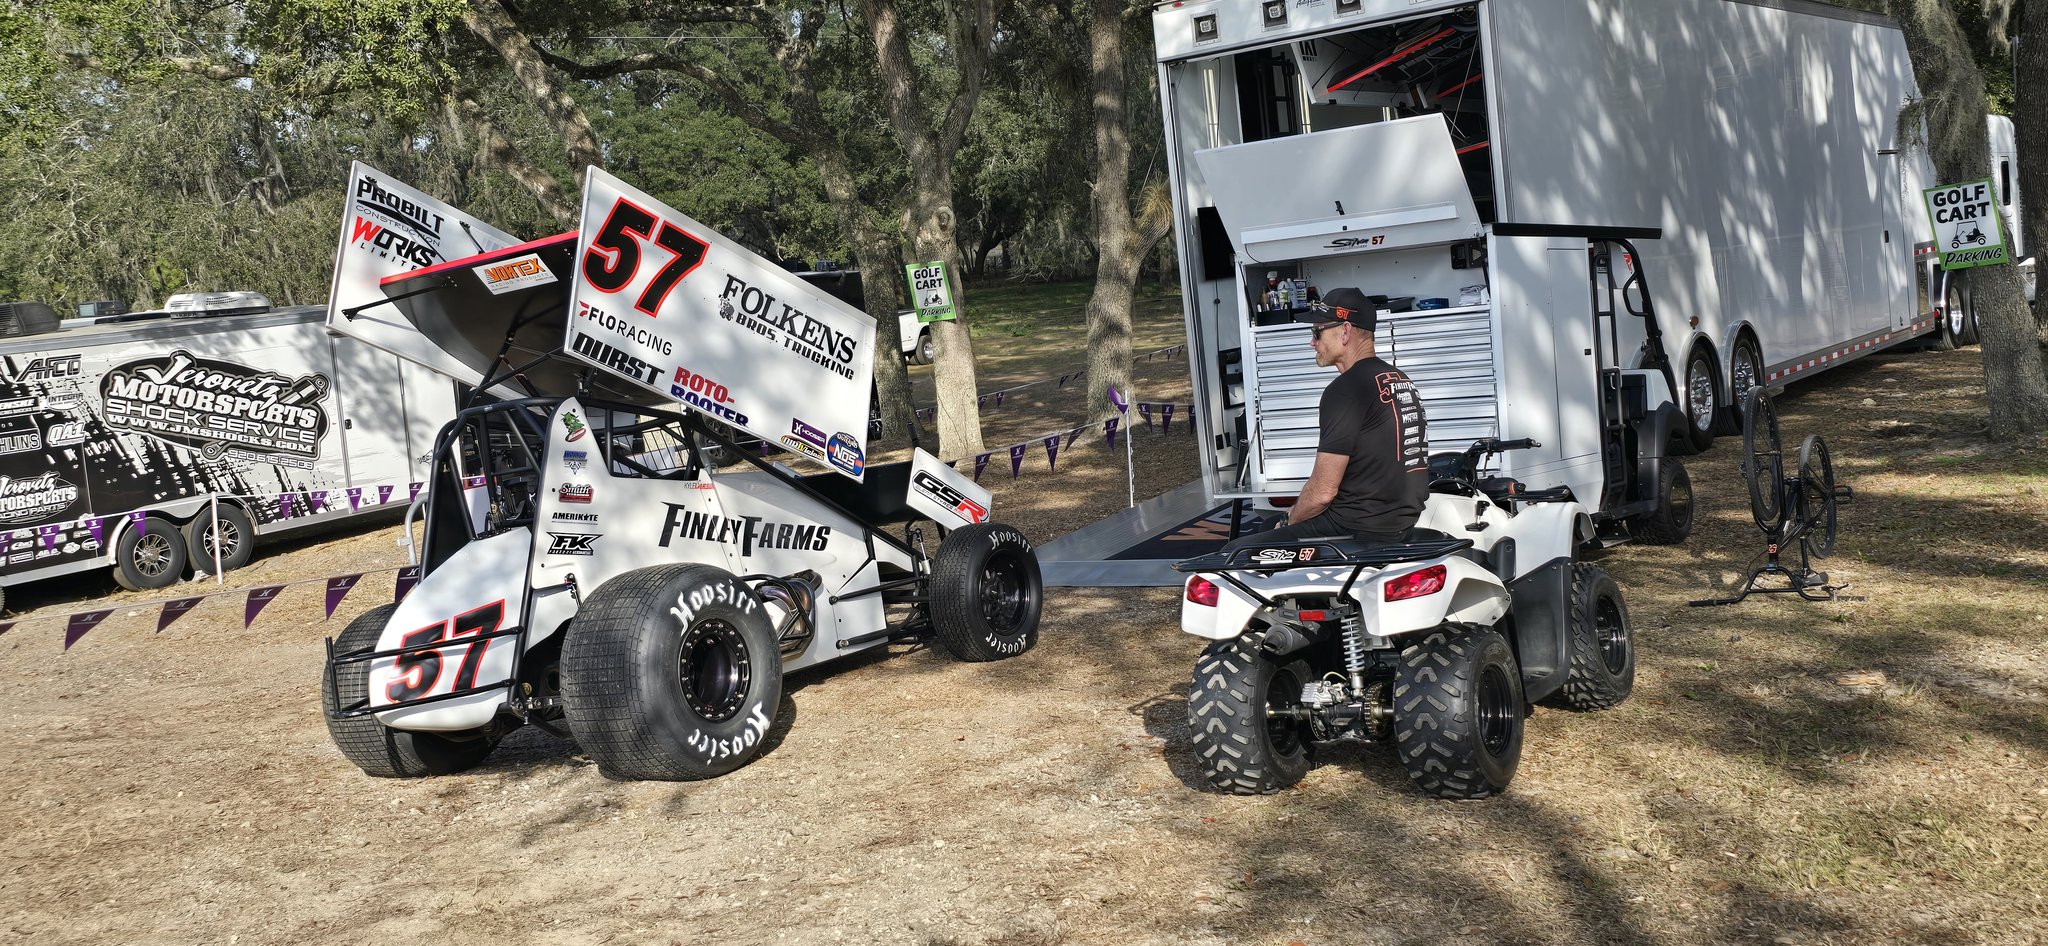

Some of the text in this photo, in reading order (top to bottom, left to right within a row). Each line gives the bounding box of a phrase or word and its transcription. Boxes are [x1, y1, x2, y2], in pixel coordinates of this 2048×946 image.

[357, 178, 444, 233] PROBILT
[1933, 185, 1985, 207] GOLF
[1936, 201, 1989, 223] CART
[352, 216, 436, 267] WORKS
[1372, 235, 1385, 245] 57
[360, 242, 417, 270] LIMITE
[582, 196, 710, 318] 57
[1944, 247, 2002, 267] PARKING
[485, 258, 546, 283] VORTEX
[914, 267, 940, 279] GOLF
[915, 278, 943, 290] CART
[722, 273, 857, 364] FOLKENS
[921, 308, 951, 318] PARKING
[1336, 306, 1349, 320] 57
[572, 332, 665, 386] DURST
[735, 312, 855, 380] BROS. TRUCKING
[14, 354, 82, 383] AFCO
[136, 354, 293, 412] Jerovetz
[674, 366, 735, 403] ROTO-
[109, 375, 318, 429] MOTORSPORTS
[671, 384, 749, 427] ROOTER
[48, 424, 84, 442] QA1
[106, 399, 316, 444] SHOCK SERVICE
[107, 413, 316, 453] WWW.JMSHOCKS.COM
[0, 434, 40, 452] HLINS
[833, 443, 860, 470] NOS
[227, 449, 315, 471] 920.615.2508
[0, 486, 77, 512] TORSPORTS
[560, 482, 592, 495] Smith
[913, 470, 988, 524] GSR
[30, 502, 66, 515] PARTS
[552, 533, 599, 551] FK
[658, 501, 831, 557] FINLEY FARMS
[1298, 547, 1315, 561] 57
[385, 598, 505, 704] 57
